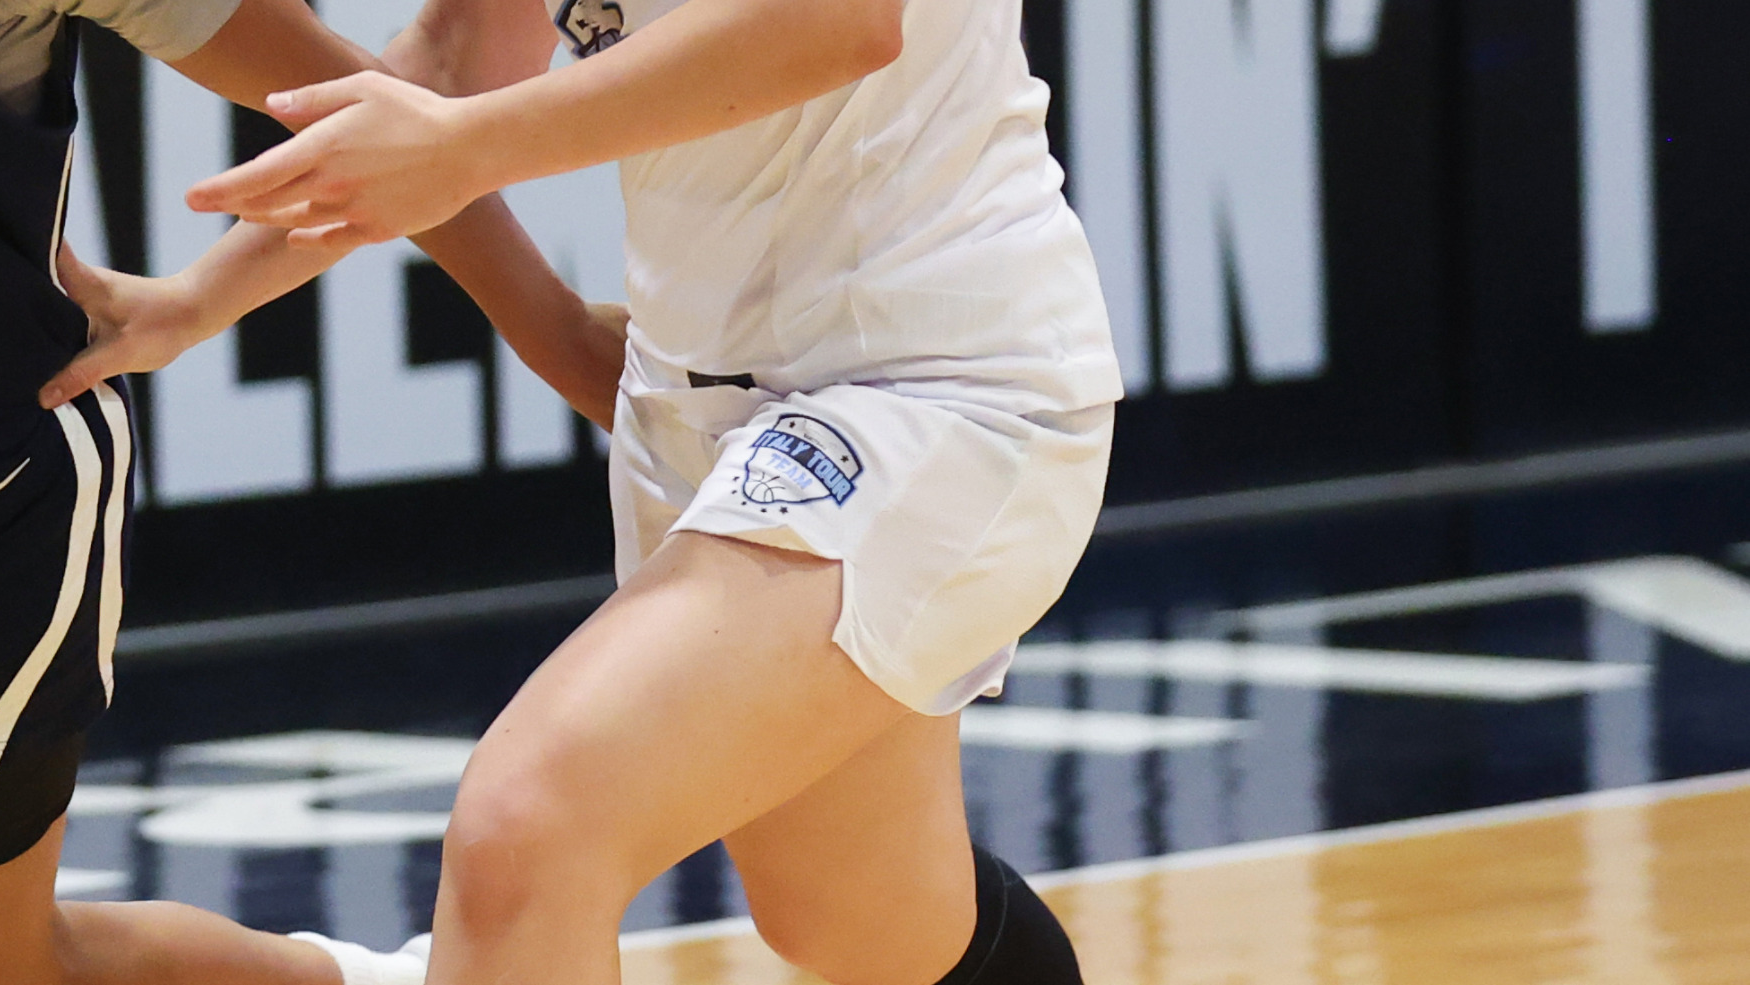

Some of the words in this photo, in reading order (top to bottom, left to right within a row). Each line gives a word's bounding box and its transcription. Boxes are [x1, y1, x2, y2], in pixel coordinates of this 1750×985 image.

[754, 431, 811, 458] ITALY
[806, 450, 853, 503] TOUR
[766, 453, 814, 490] TEAM
